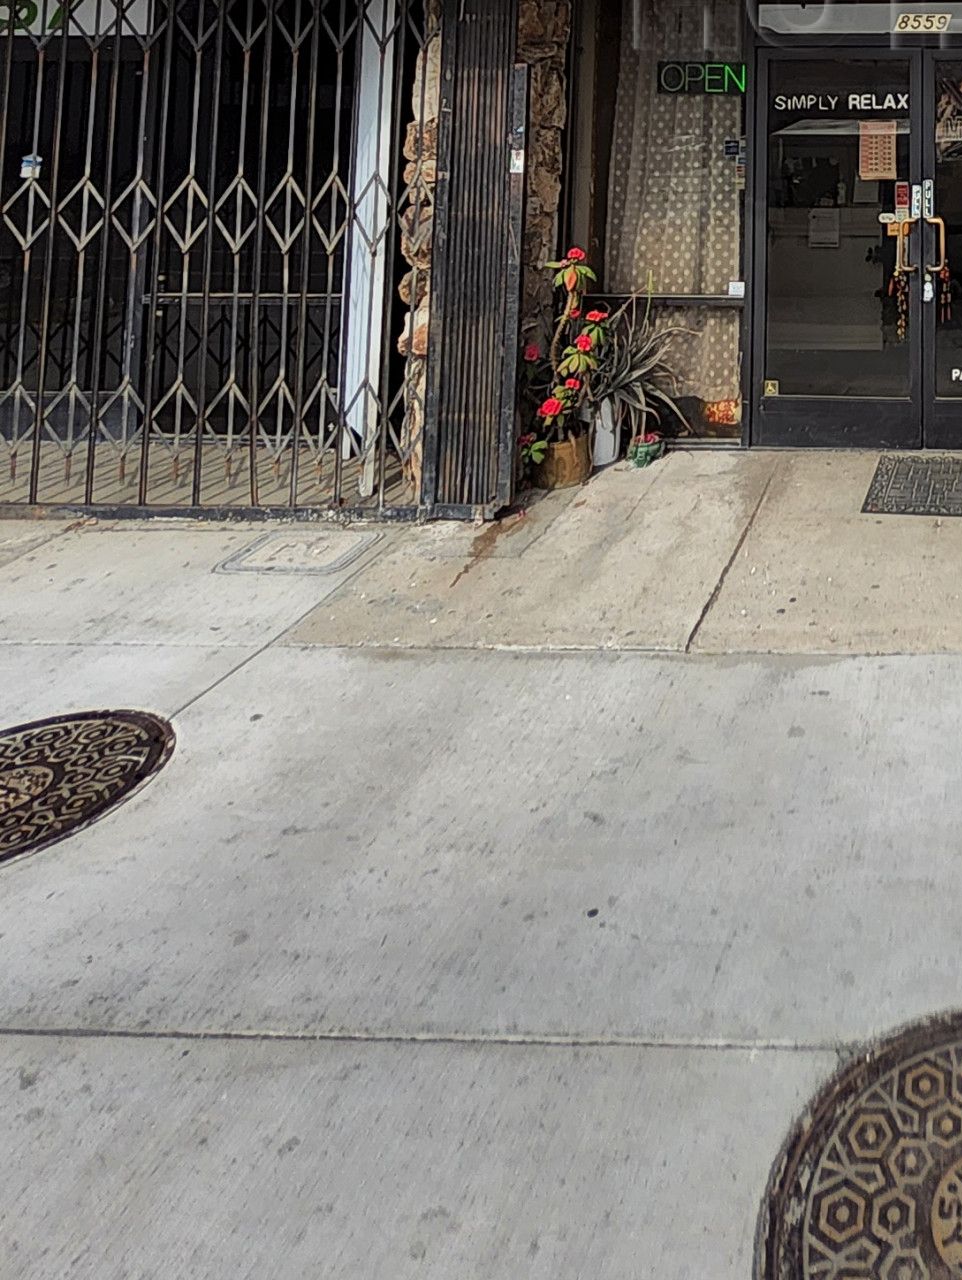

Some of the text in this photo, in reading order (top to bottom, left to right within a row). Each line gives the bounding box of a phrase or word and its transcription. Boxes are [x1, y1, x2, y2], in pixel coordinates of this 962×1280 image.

[898, 14, 948, 30] 8559
[660, 64, 746, 93] OPEN
[773, 93, 909, 111] SIMPLY RELAX
